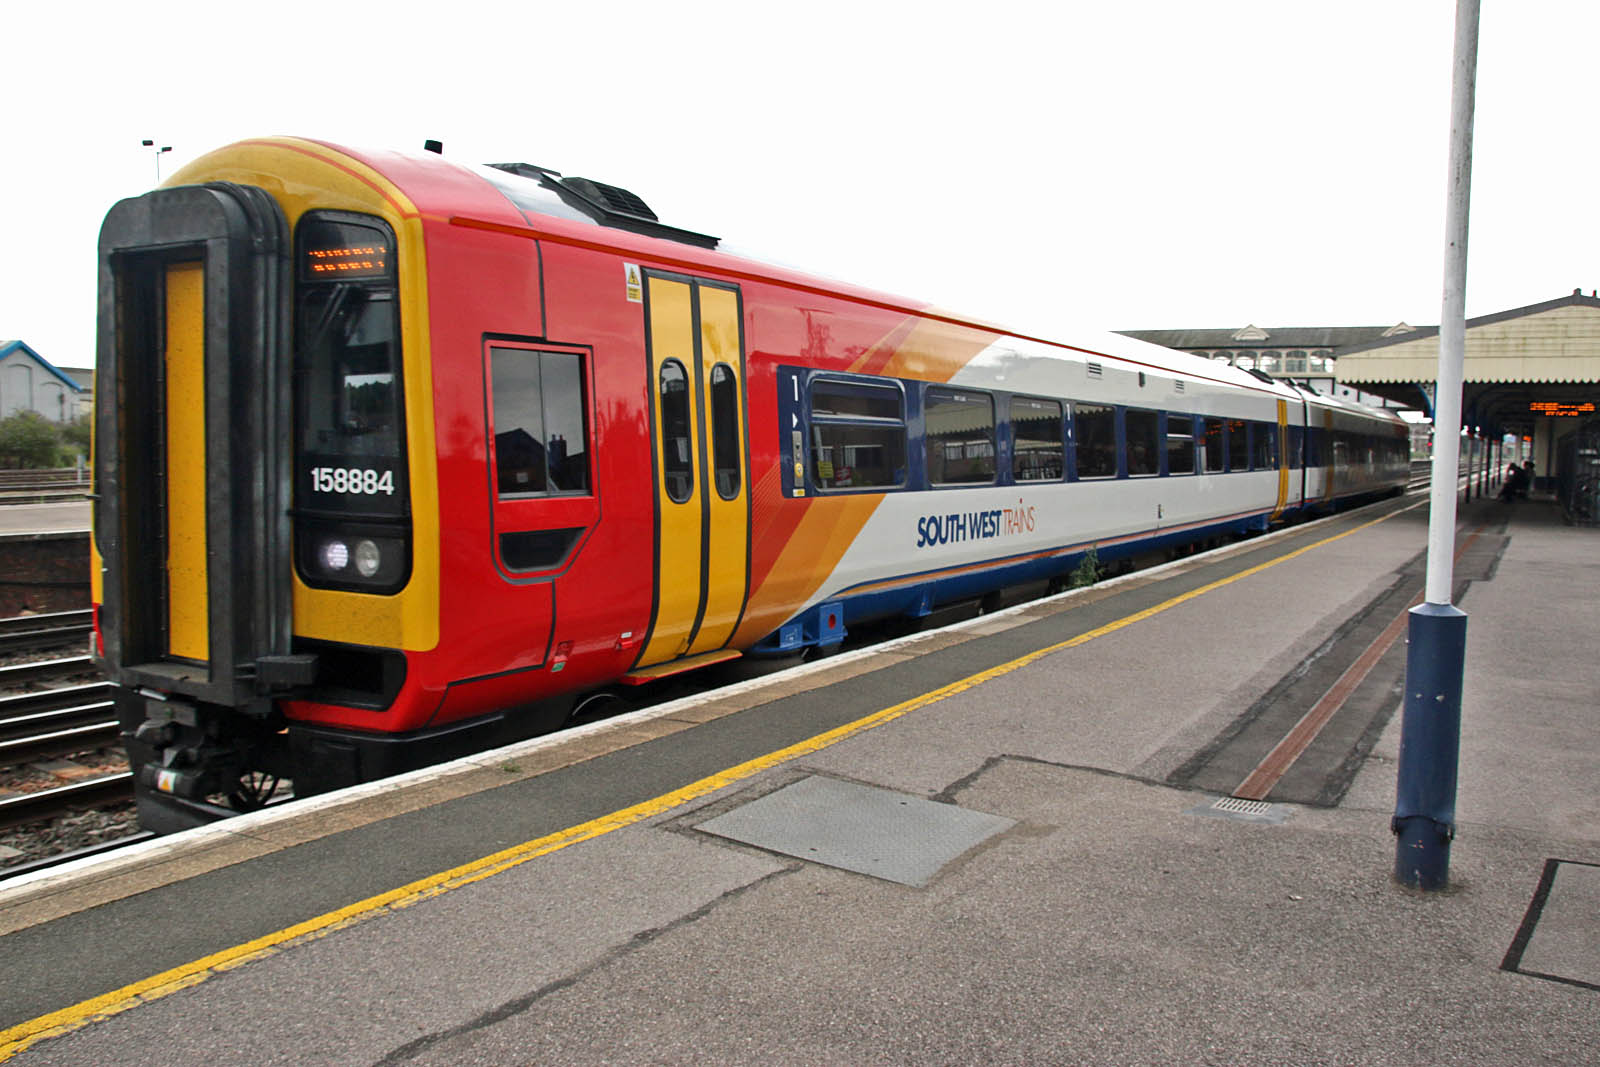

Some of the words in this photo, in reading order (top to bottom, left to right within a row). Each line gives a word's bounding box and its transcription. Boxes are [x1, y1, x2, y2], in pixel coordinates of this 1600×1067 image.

[311, 467, 394, 495] 158884
[917, 513, 966, 548] SOUTH
[969, 510, 1002, 540] WEST
[1003, 497, 1035, 536] TRAINS
